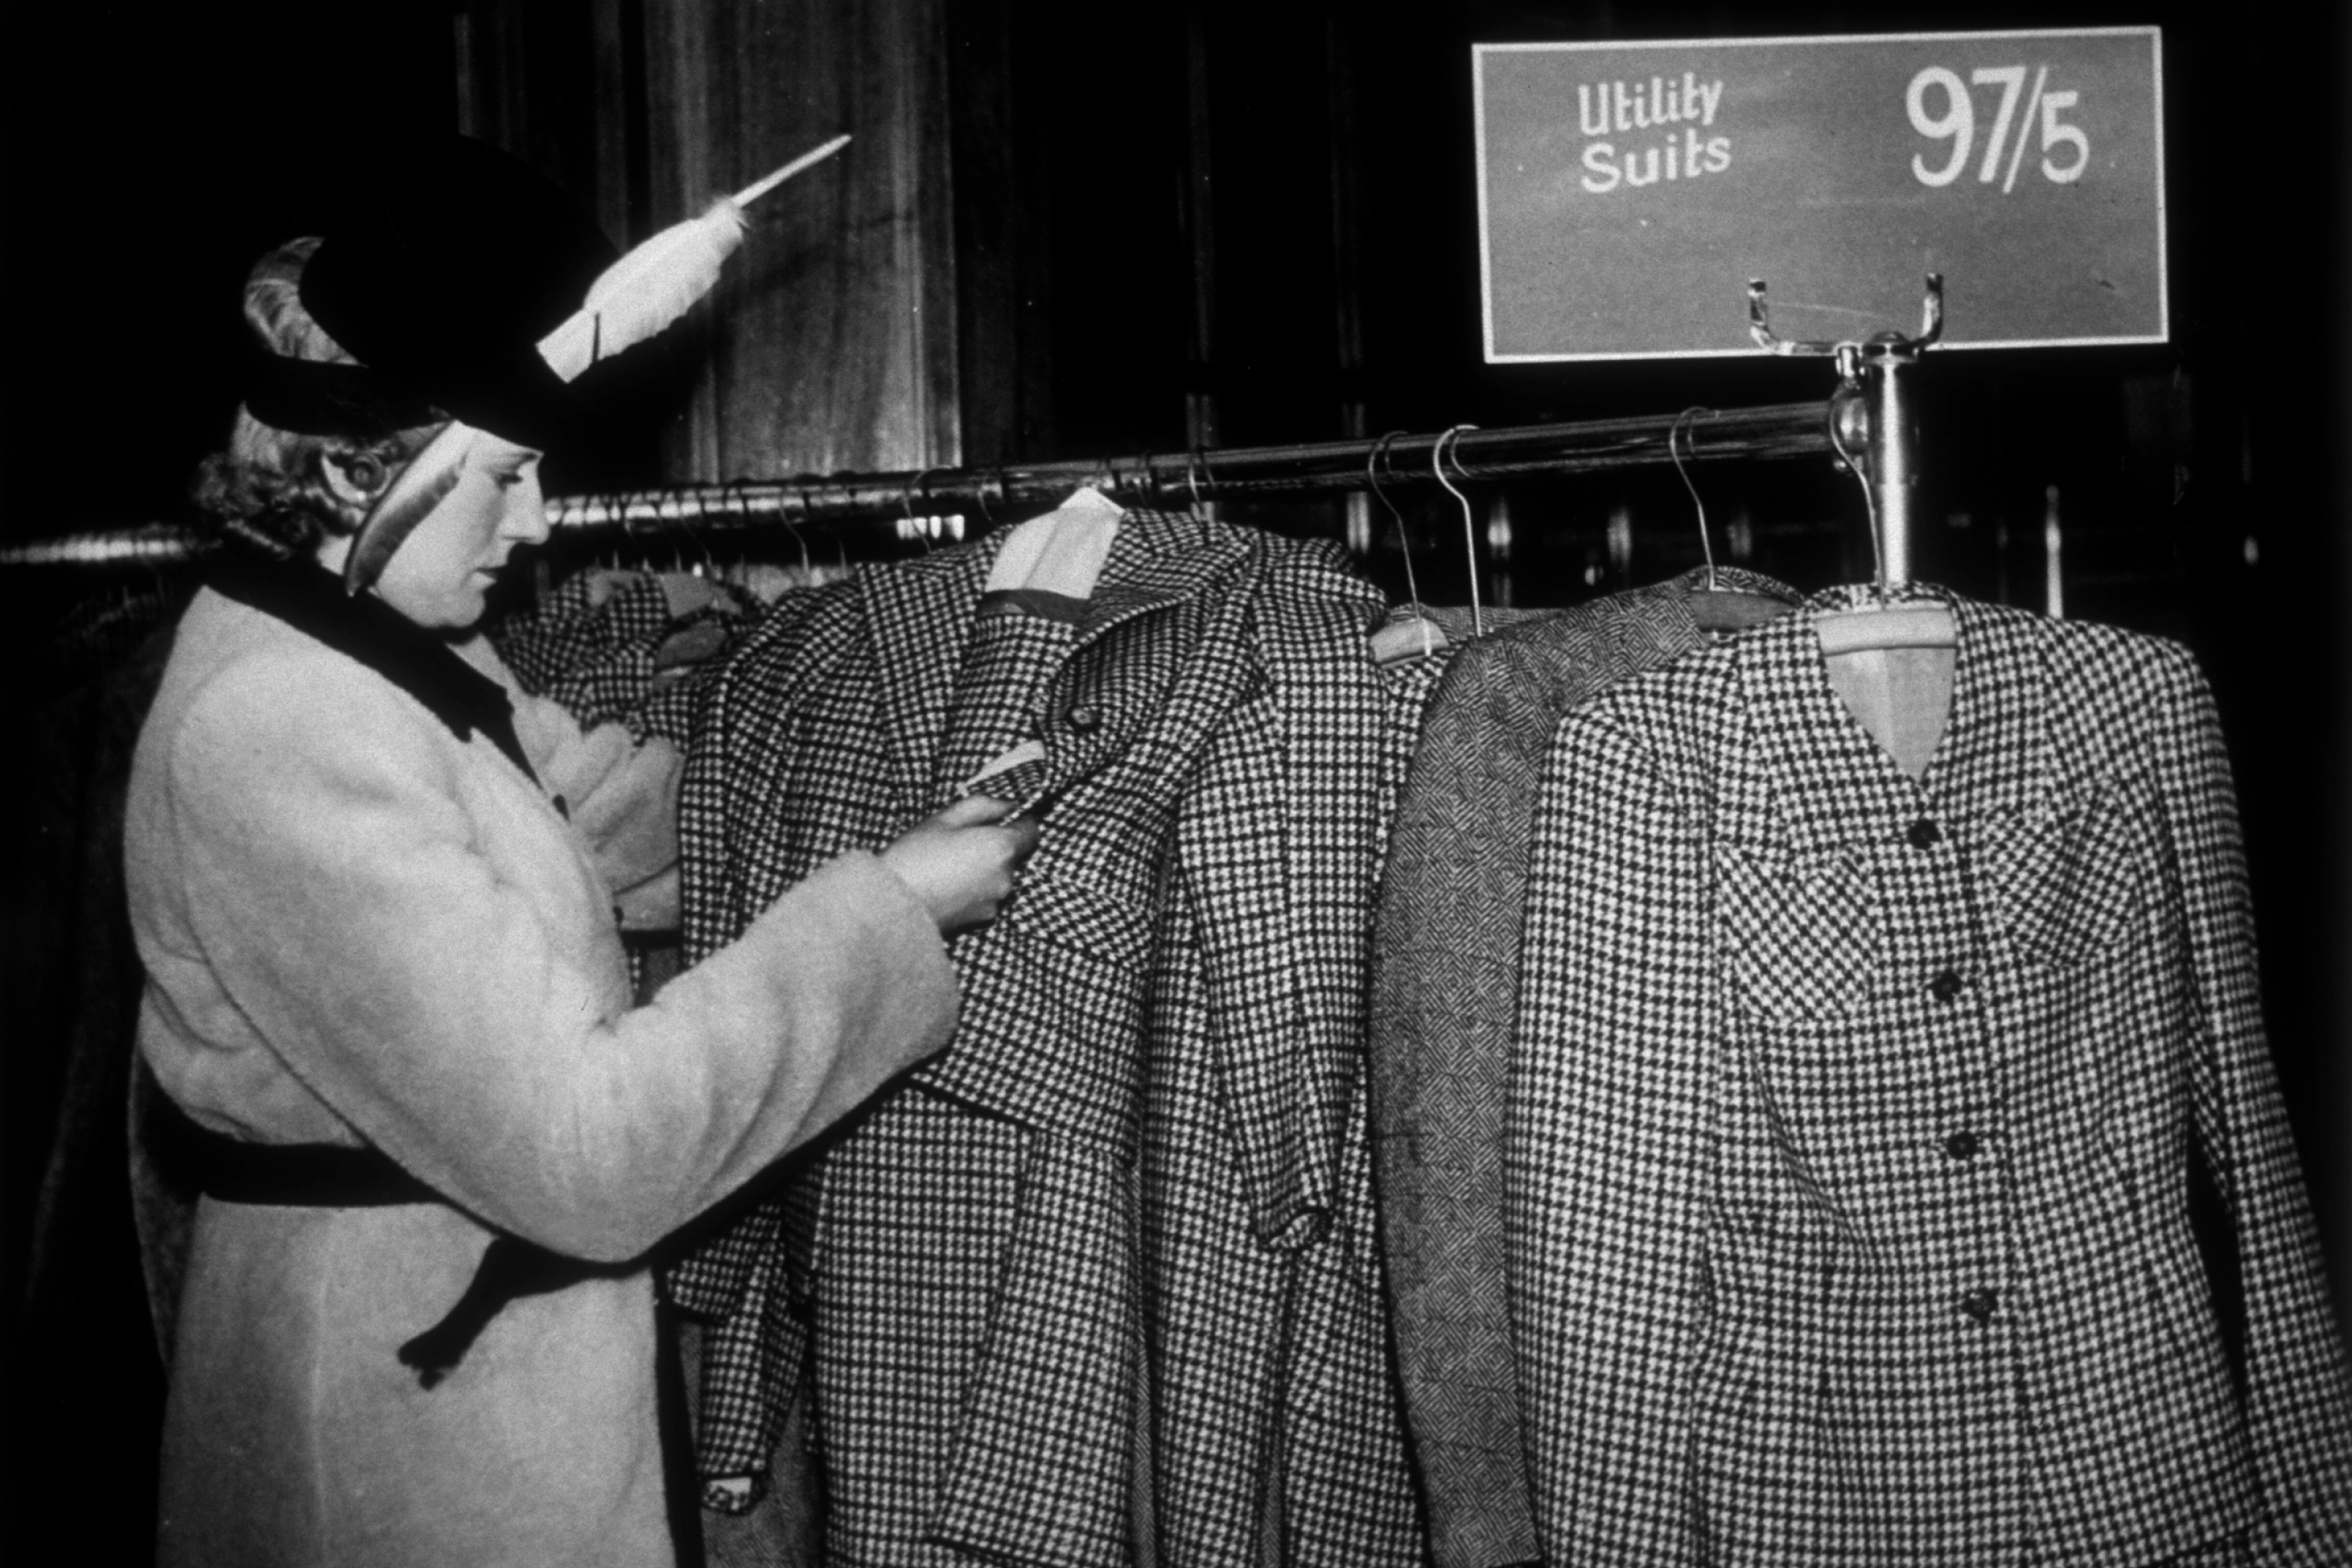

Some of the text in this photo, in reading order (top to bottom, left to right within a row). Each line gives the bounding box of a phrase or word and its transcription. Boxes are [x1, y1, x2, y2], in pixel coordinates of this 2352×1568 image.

[1578, 71, 1724, 136] Utility
[1906, 66, 2090, 194] 97/5
[1580, 127, 1733, 194] Suits
